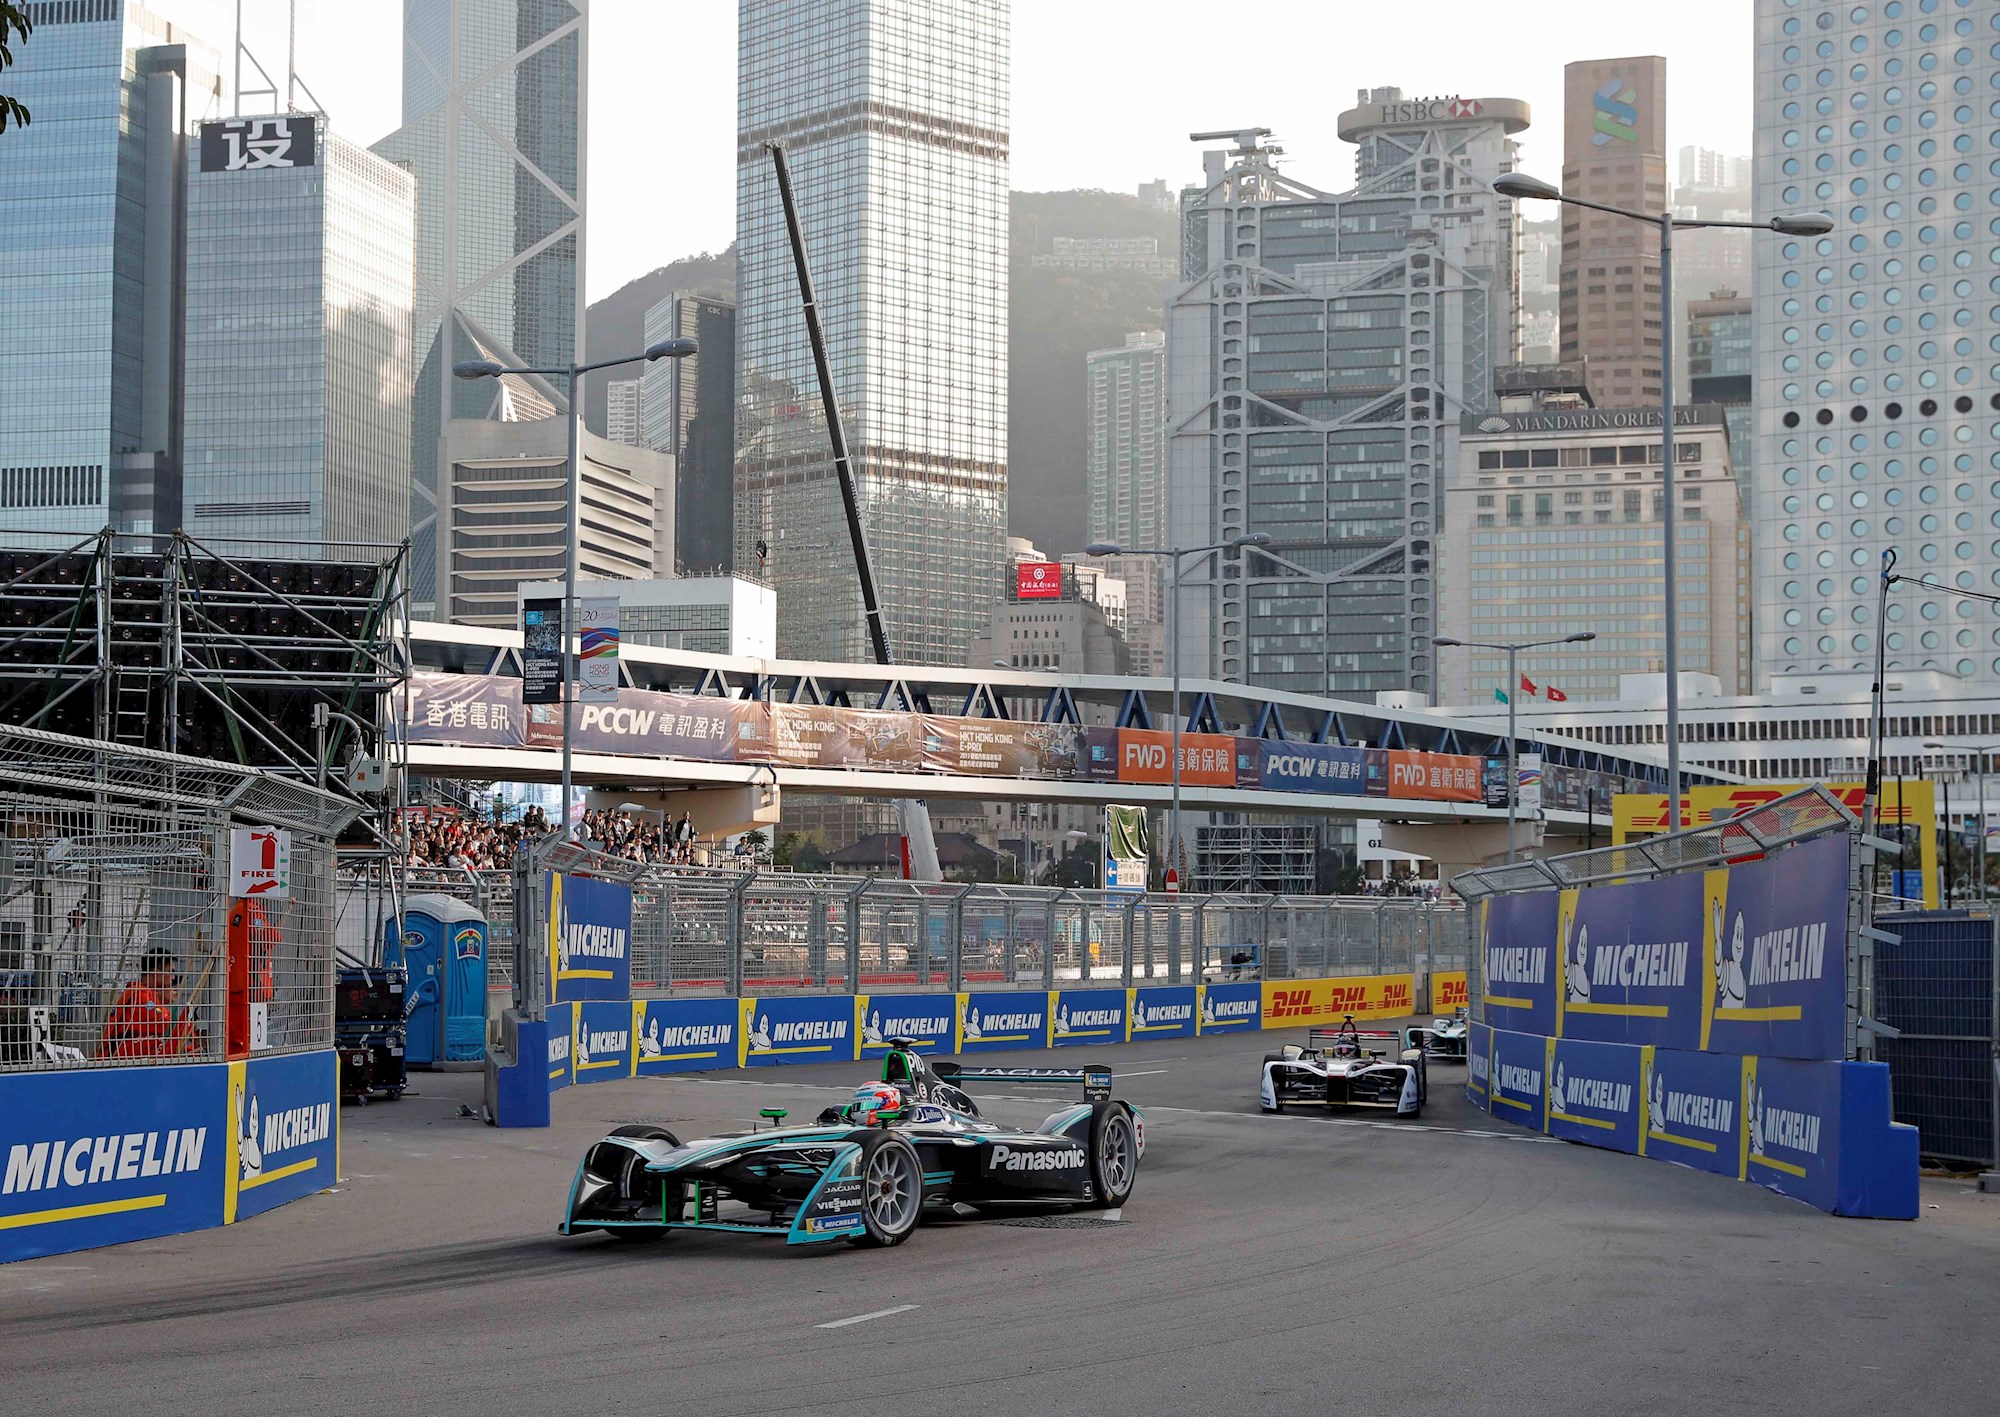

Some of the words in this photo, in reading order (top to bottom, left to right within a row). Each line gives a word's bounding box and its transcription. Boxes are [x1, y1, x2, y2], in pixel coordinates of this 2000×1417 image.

[1381, 102, 1445, 123] HSBC
[223, 122, 295, 169] 设
[1516, 413, 1610, 431] MANDARIN
[583, 610, 598, 621] 20
[426, 699, 510, 731] 香港電訊
[580, 705, 656, 736] PCCW
[658, 713, 726, 740] 電訊盈科
[793, 720, 813, 731] HONG
[814, 721, 836, 732] KONG
[960, 731, 974, 742] HKT
[975, 732, 994, 743] HONG
[994, 733, 1013, 744] KONG
[960, 741, 983, 752] E-PRIX
[1125, 743, 1167, 769] FWD
[1266, 755, 1316, 778] PCCW
[1317, 760, 1361, 780] 電訊盈科
[1394, 763, 1426, 786] FWD
[1430, 766, 1476, 790] 富衛保險
[242, 870, 275, 878] FIRE
[568, 923, 626, 959] MICHELIN
[1489, 947, 1547, 984] MICHELIN
[1593, 942, 1688, 987] MICHELIN
[1749, 923, 1827, 986] MICHELIN
[1216, 1000, 1258, 1017] MICHELIN
[1272, 989, 1313, 1018] DHL
[1331, 986, 1368, 1013] DHL
[1383, 984, 1408, 1009] DHL
[983, 1013, 1042, 1031] MICHELIN
[1071, 1010, 1121, 1027] MICHELIN
[1147, 1005, 1192, 1021] MICHELIN
[256, 1010, 262, 1043] 5
[662, 1025, 732, 1048] MICHELIN
[773, 1020, 848, 1042] MICHELIN
[884, 1017, 949, 1036] MICHELIN
[589, 1030, 628, 1055] MICHELIN
[1501, 1064, 1541, 1096] MICHELIN
[1567, 1077, 1631, 1113] MICHELIN
[1667, 1091, 1732, 1133] MICHELIN
[264, 1102, 330, 1155] MICHELIN
[1765, 1107, 1820, 1154] MICHELIN
[2, 1127, 206, 1195] MICHELIN
[989, 1144, 1085, 1170] Panasonic
[824, 1184, 861, 1194] JAGUAR
[816, 1197, 862, 1213] VIESSMANN
[824, 1218, 858, 1229] MICHELIN
